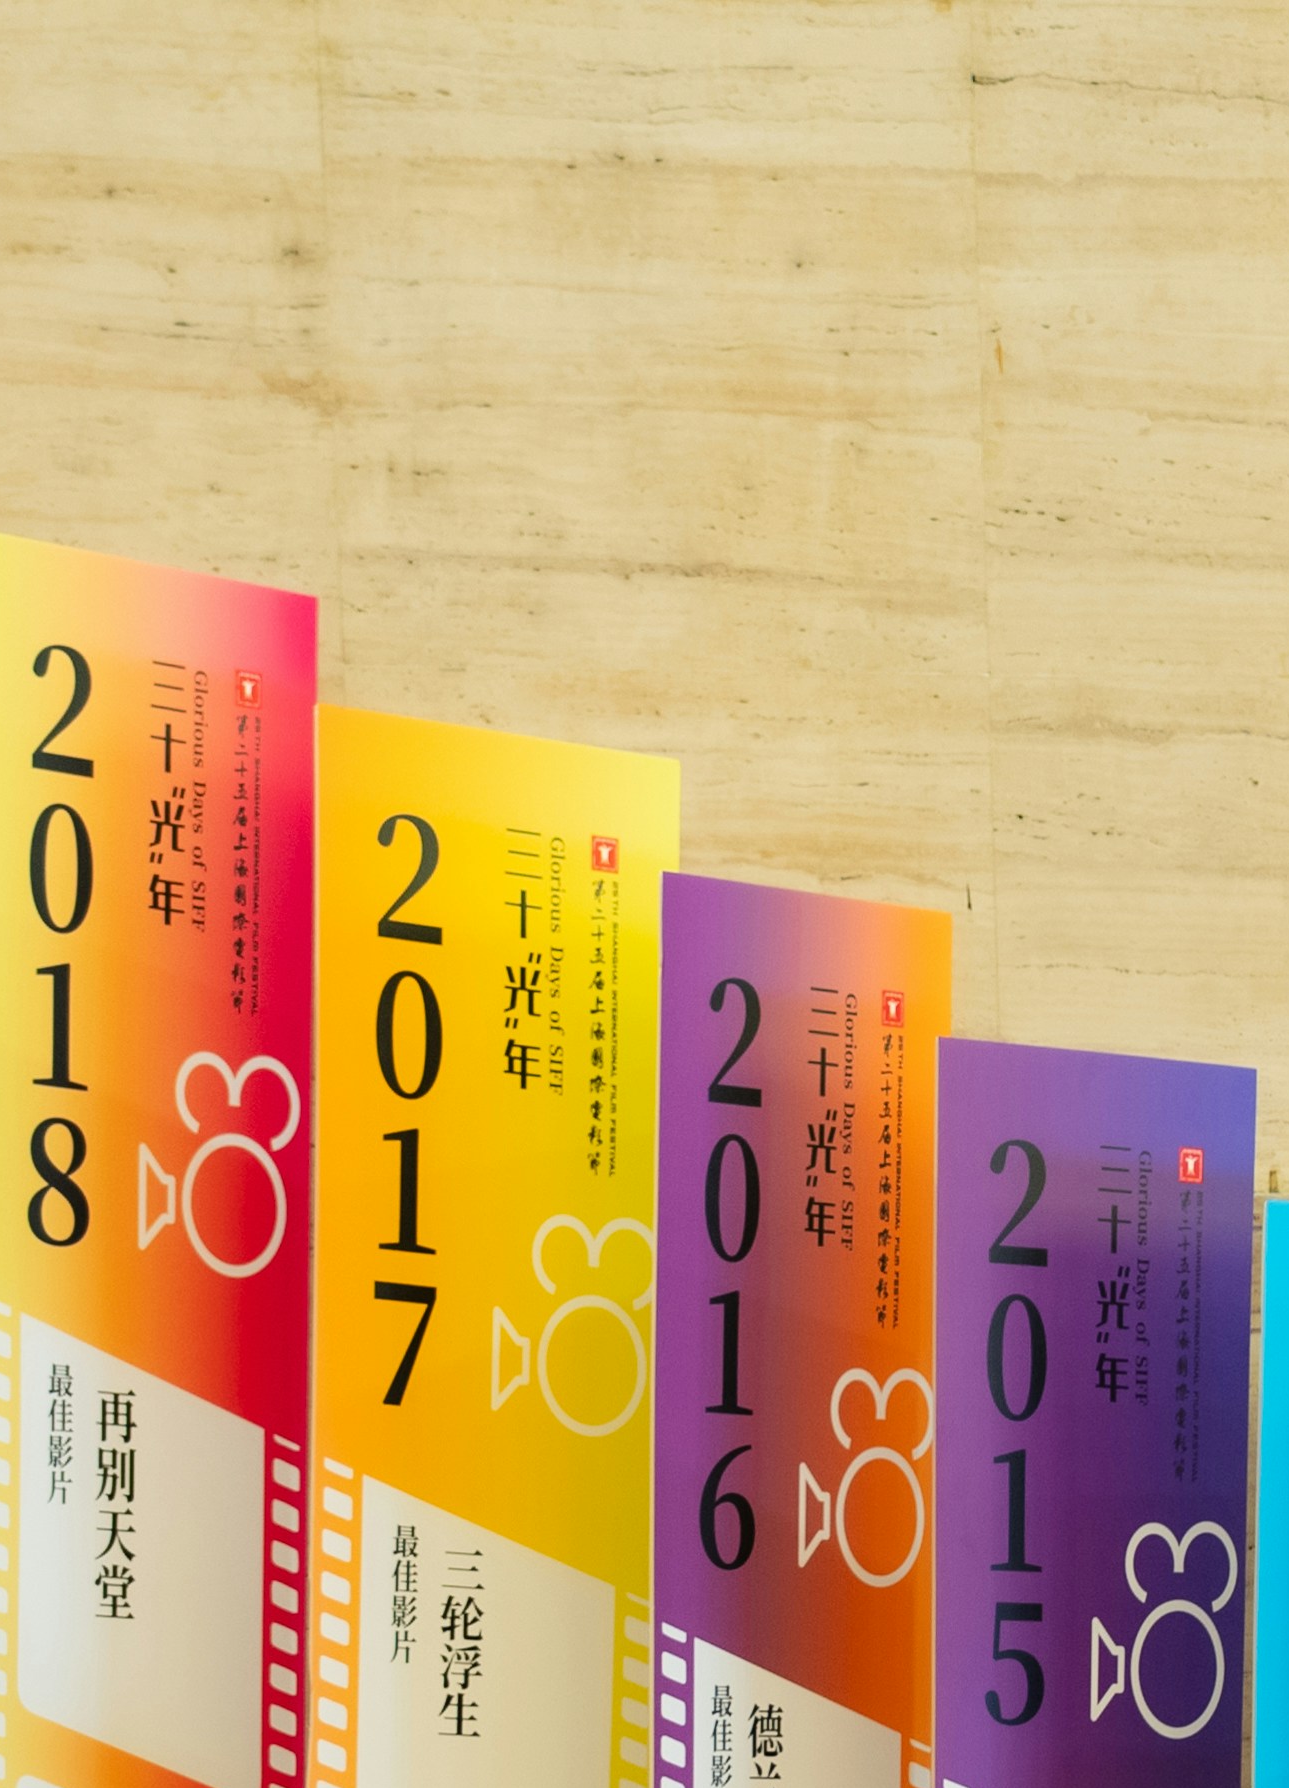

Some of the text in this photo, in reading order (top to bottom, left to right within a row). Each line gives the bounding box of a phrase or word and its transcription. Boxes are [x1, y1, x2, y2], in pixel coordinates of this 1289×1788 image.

[189, 670, 208, 933] Glorious Days of SIFF
[27, 644, 94, 1247] 2018
[545, 837, 566, 1097] Glorious Days of SIFF
[373, 813, 443, 1406] 2017
[839, 993, 858, 1252] Glorious Days of SIFF
[699, 977, 762, 1571] 2016
[1132, 1151, 1152, 1407] Glorious Days of SIFF
[47, 1363, 74, 1505] 最佳影片
[94, 1389, 138, 1620] 再别天堂
[984, 1139, 1048, 1726] 2015
[390, 1525, 419, 1664] 最佳影片
[438, 1548, 484, 1738] 三轮浮生
